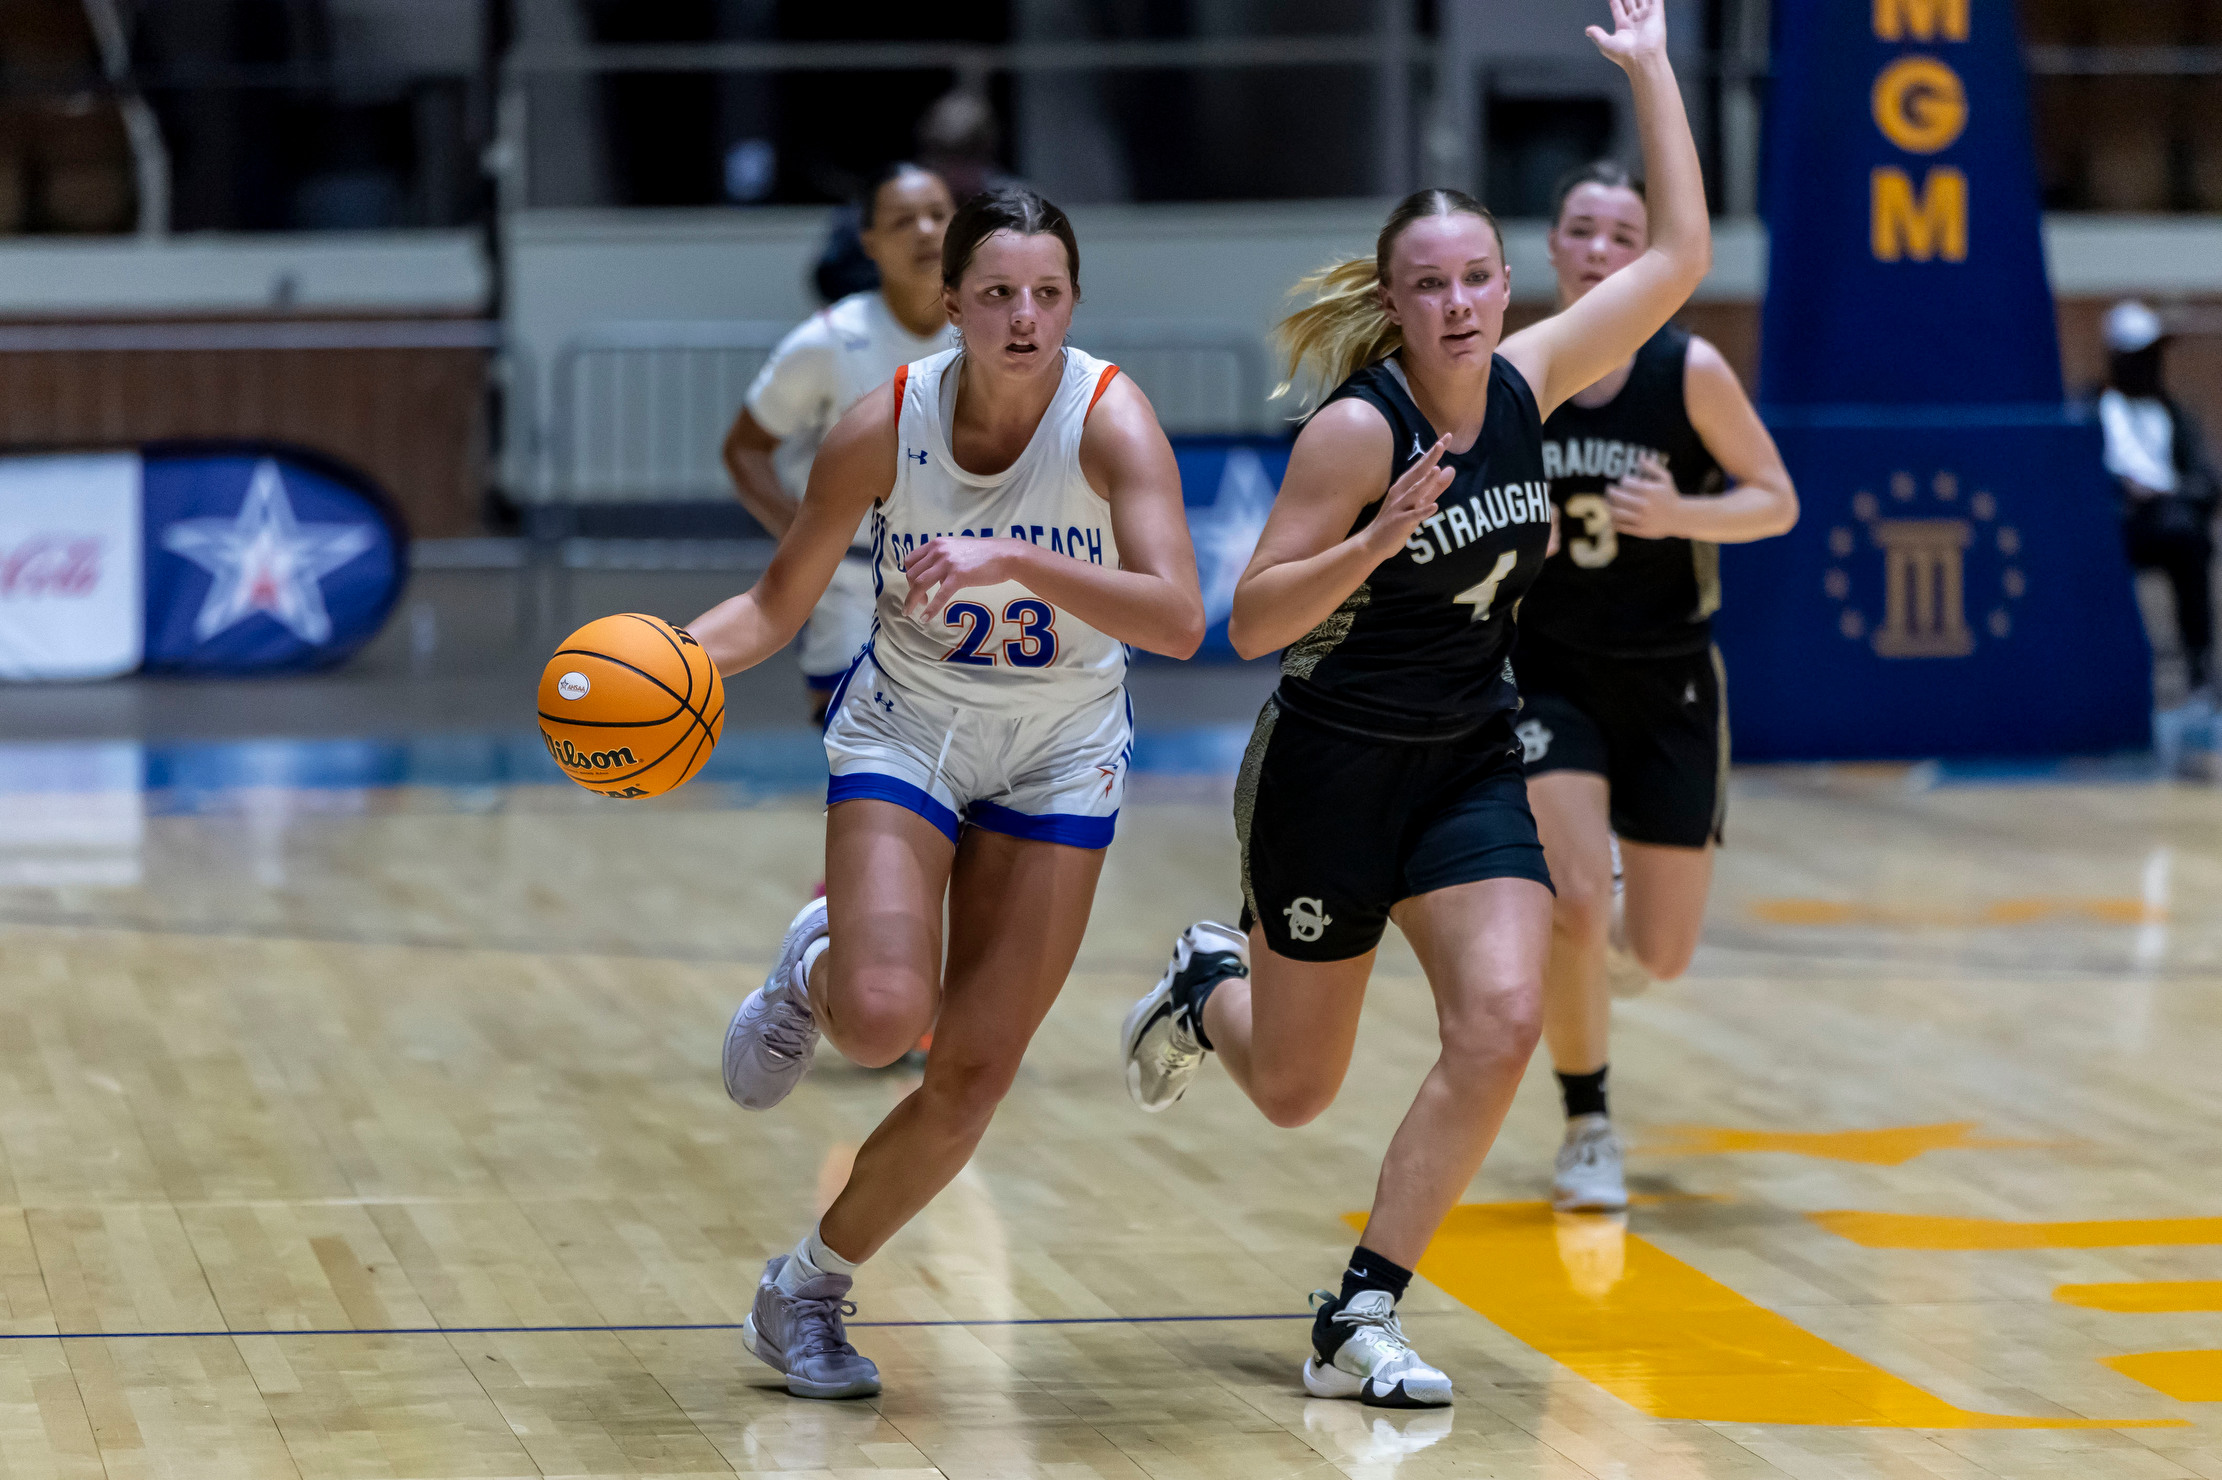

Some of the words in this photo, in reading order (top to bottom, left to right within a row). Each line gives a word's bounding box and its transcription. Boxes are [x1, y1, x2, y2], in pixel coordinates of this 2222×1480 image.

[1565, 493, 1619, 568] 3
[1453, 550, 1517, 623] 4
[941, 597, 1060, 669] 23
